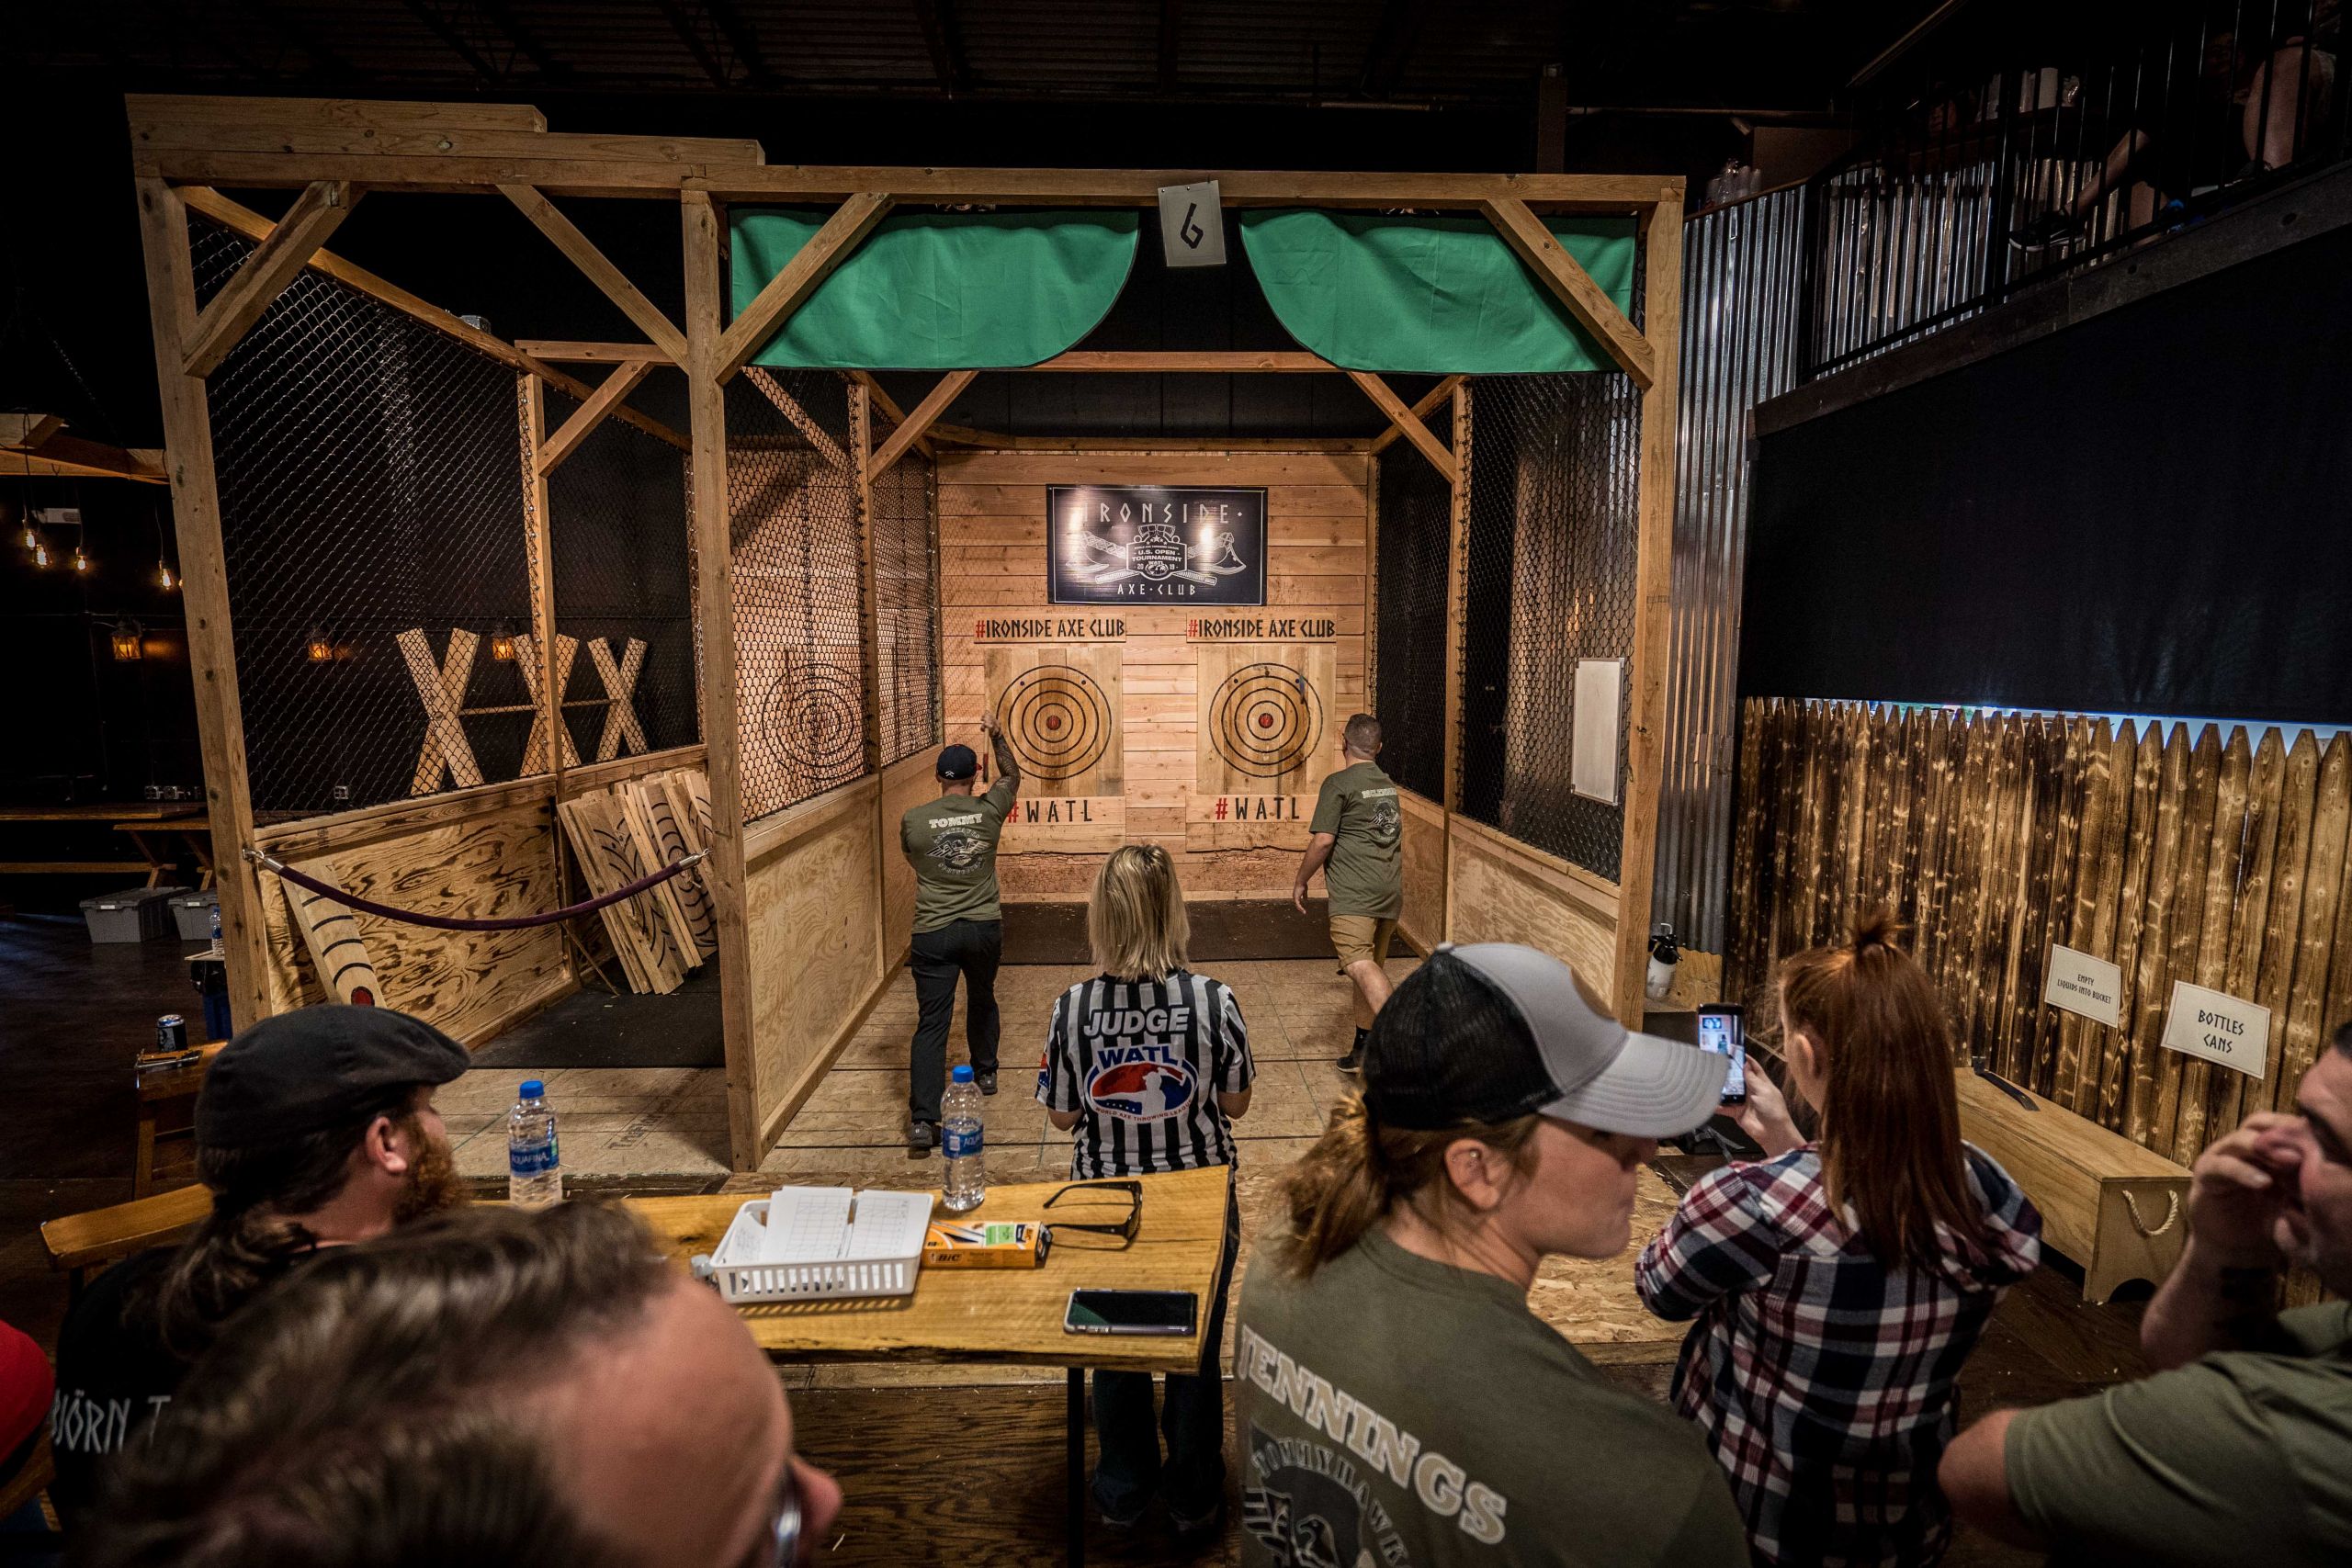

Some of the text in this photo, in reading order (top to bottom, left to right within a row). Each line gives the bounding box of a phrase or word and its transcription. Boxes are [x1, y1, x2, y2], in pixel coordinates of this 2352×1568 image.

[1181, 202, 1204, 249] 6
[1057, 618, 1085, 637] AXE
[1089, 618, 1125, 637] CLUB
[1268, 619, 1296, 637] AXE
[1300, 619, 1336, 637] CLUB
[929, 813, 983, 829] TOMMY
[2057, 978, 2111, 1004] LIQUIDS INTO BUCKET
[2077, 974, 2095, 987] EMPTY
[1083, 1007, 1190, 1036] JUDGE
[2198, 1010, 2245, 1036] BOTTLES
[2203, 1033, 2233, 1054] CANS
[1097, 1045, 1179, 1070] WATL
[1095, 1106, 1118, 1116] WORLD
[1133, 1111, 1169, 1122] THROWING
[1237, 1323, 1508, 1545] JENNINGS
